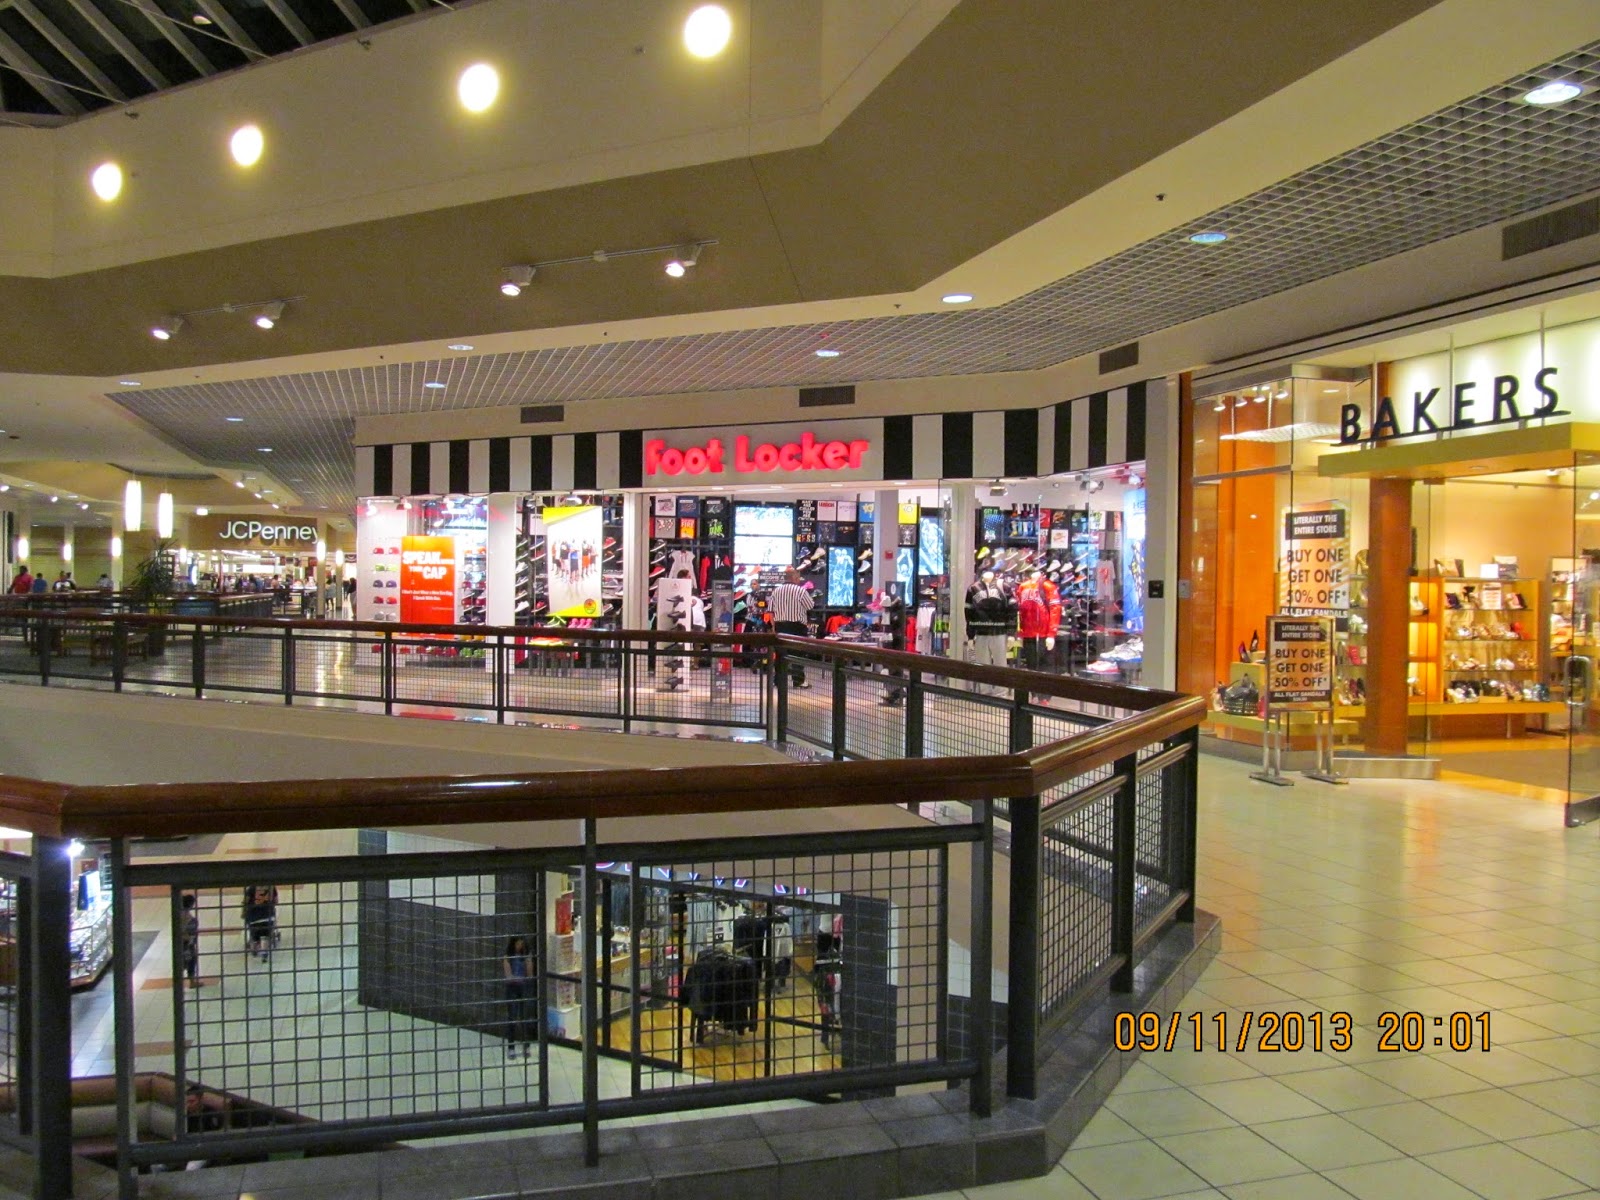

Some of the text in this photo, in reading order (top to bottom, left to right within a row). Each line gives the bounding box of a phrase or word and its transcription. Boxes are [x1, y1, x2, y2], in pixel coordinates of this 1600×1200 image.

[1340, 367, 1559, 444] BAKERS
[646, 432, 869, 476] Foot Locker
[1294, 514, 1337, 524] LITERALLY THE
[219, 521, 319, 544] JCPenney
[1294, 525, 1337, 535] ENTIRE STORE
[402, 551, 441, 565] SPEAK
[1287, 548, 1344, 562] BUY ONE
[422, 566, 447, 579] CAP
[1288, 569, 1342, 583] GET ONE
[1286, 589, 1313, 604] 50%
[1313, 609, 1348, 618] SANDALS
[1275, 648, 1325, 658] BUY ONE
[1276, 663, 1324, 673] GET ONE
[1274, 677, 1299, 687] 50%
